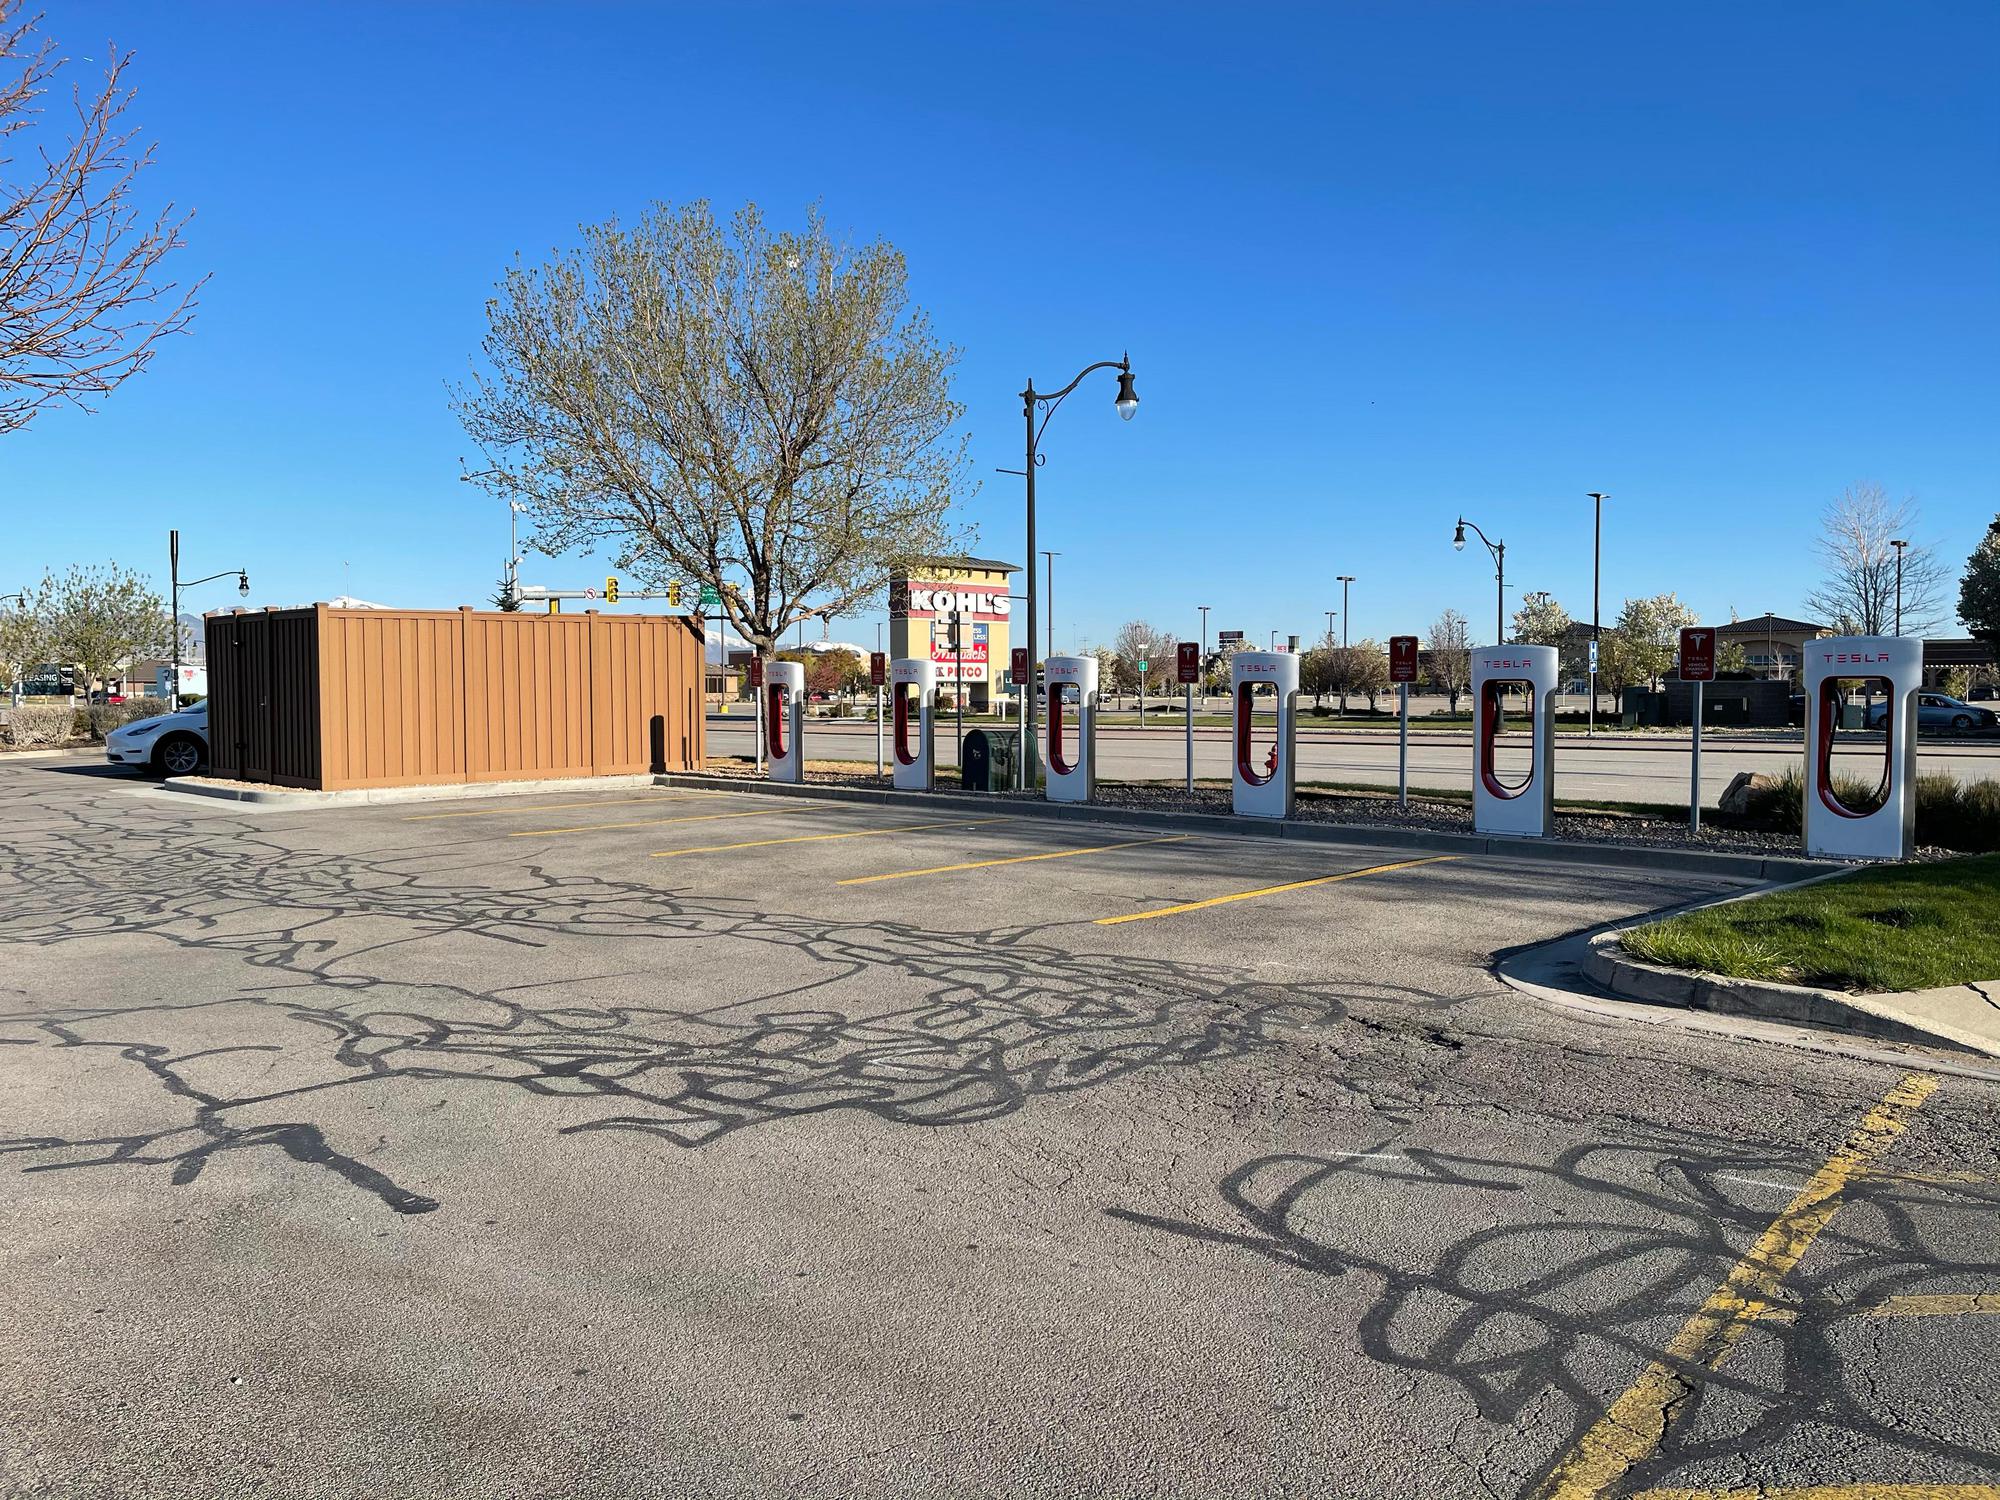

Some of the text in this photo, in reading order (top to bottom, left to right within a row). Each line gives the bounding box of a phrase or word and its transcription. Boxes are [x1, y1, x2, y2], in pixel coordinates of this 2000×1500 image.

[911, 589, 1010, 615] KOHL'S
[1823, 653, 1889, 664] TESLA
[1239, 664, 1277, 672] TESLA
[1483, 659, 1532, 669] TESLA
